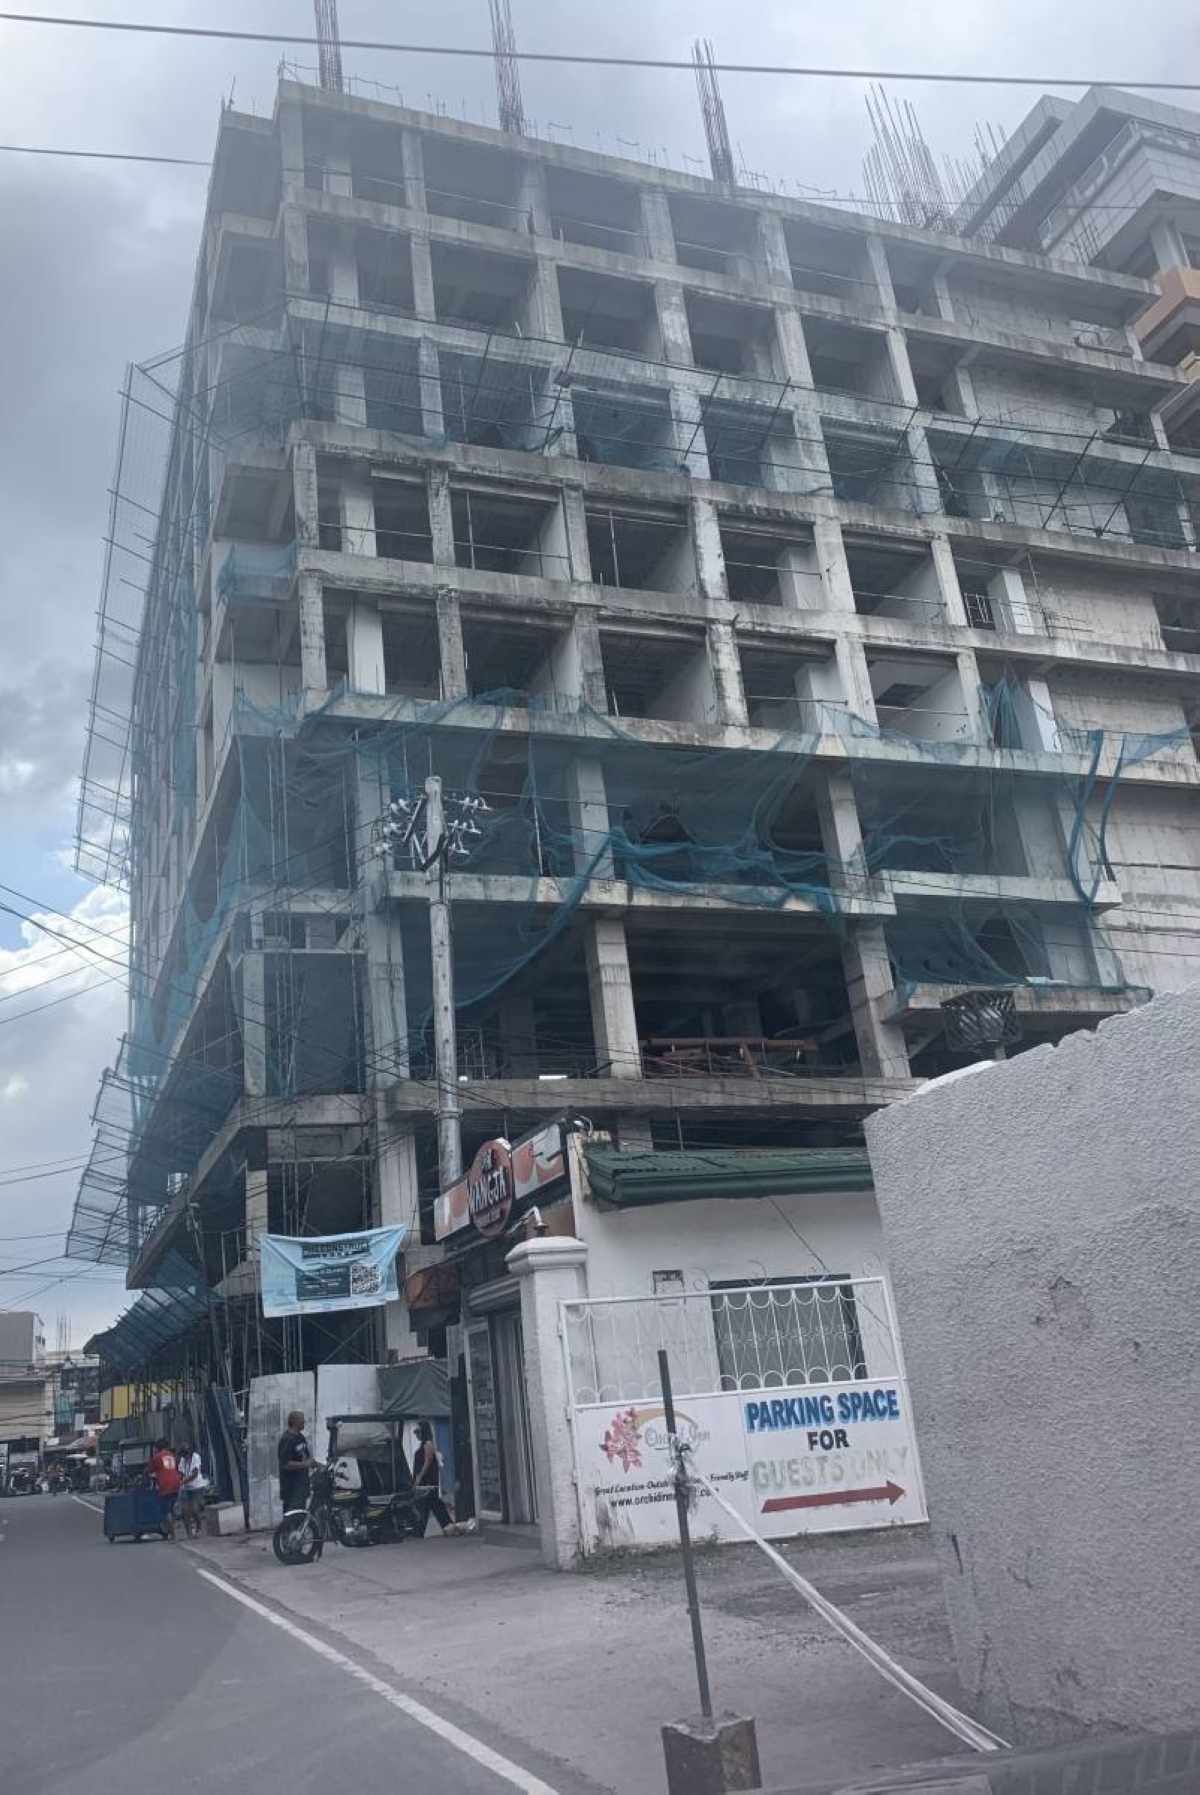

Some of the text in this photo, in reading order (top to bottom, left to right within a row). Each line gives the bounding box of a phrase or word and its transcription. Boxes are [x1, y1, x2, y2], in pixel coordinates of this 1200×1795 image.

[744, 1389, 900, 1433] PARKING SPACE
[807, 1429, 850, 1451] FOR
[752, 1447, 909, 1490] GUESTS ONLY
